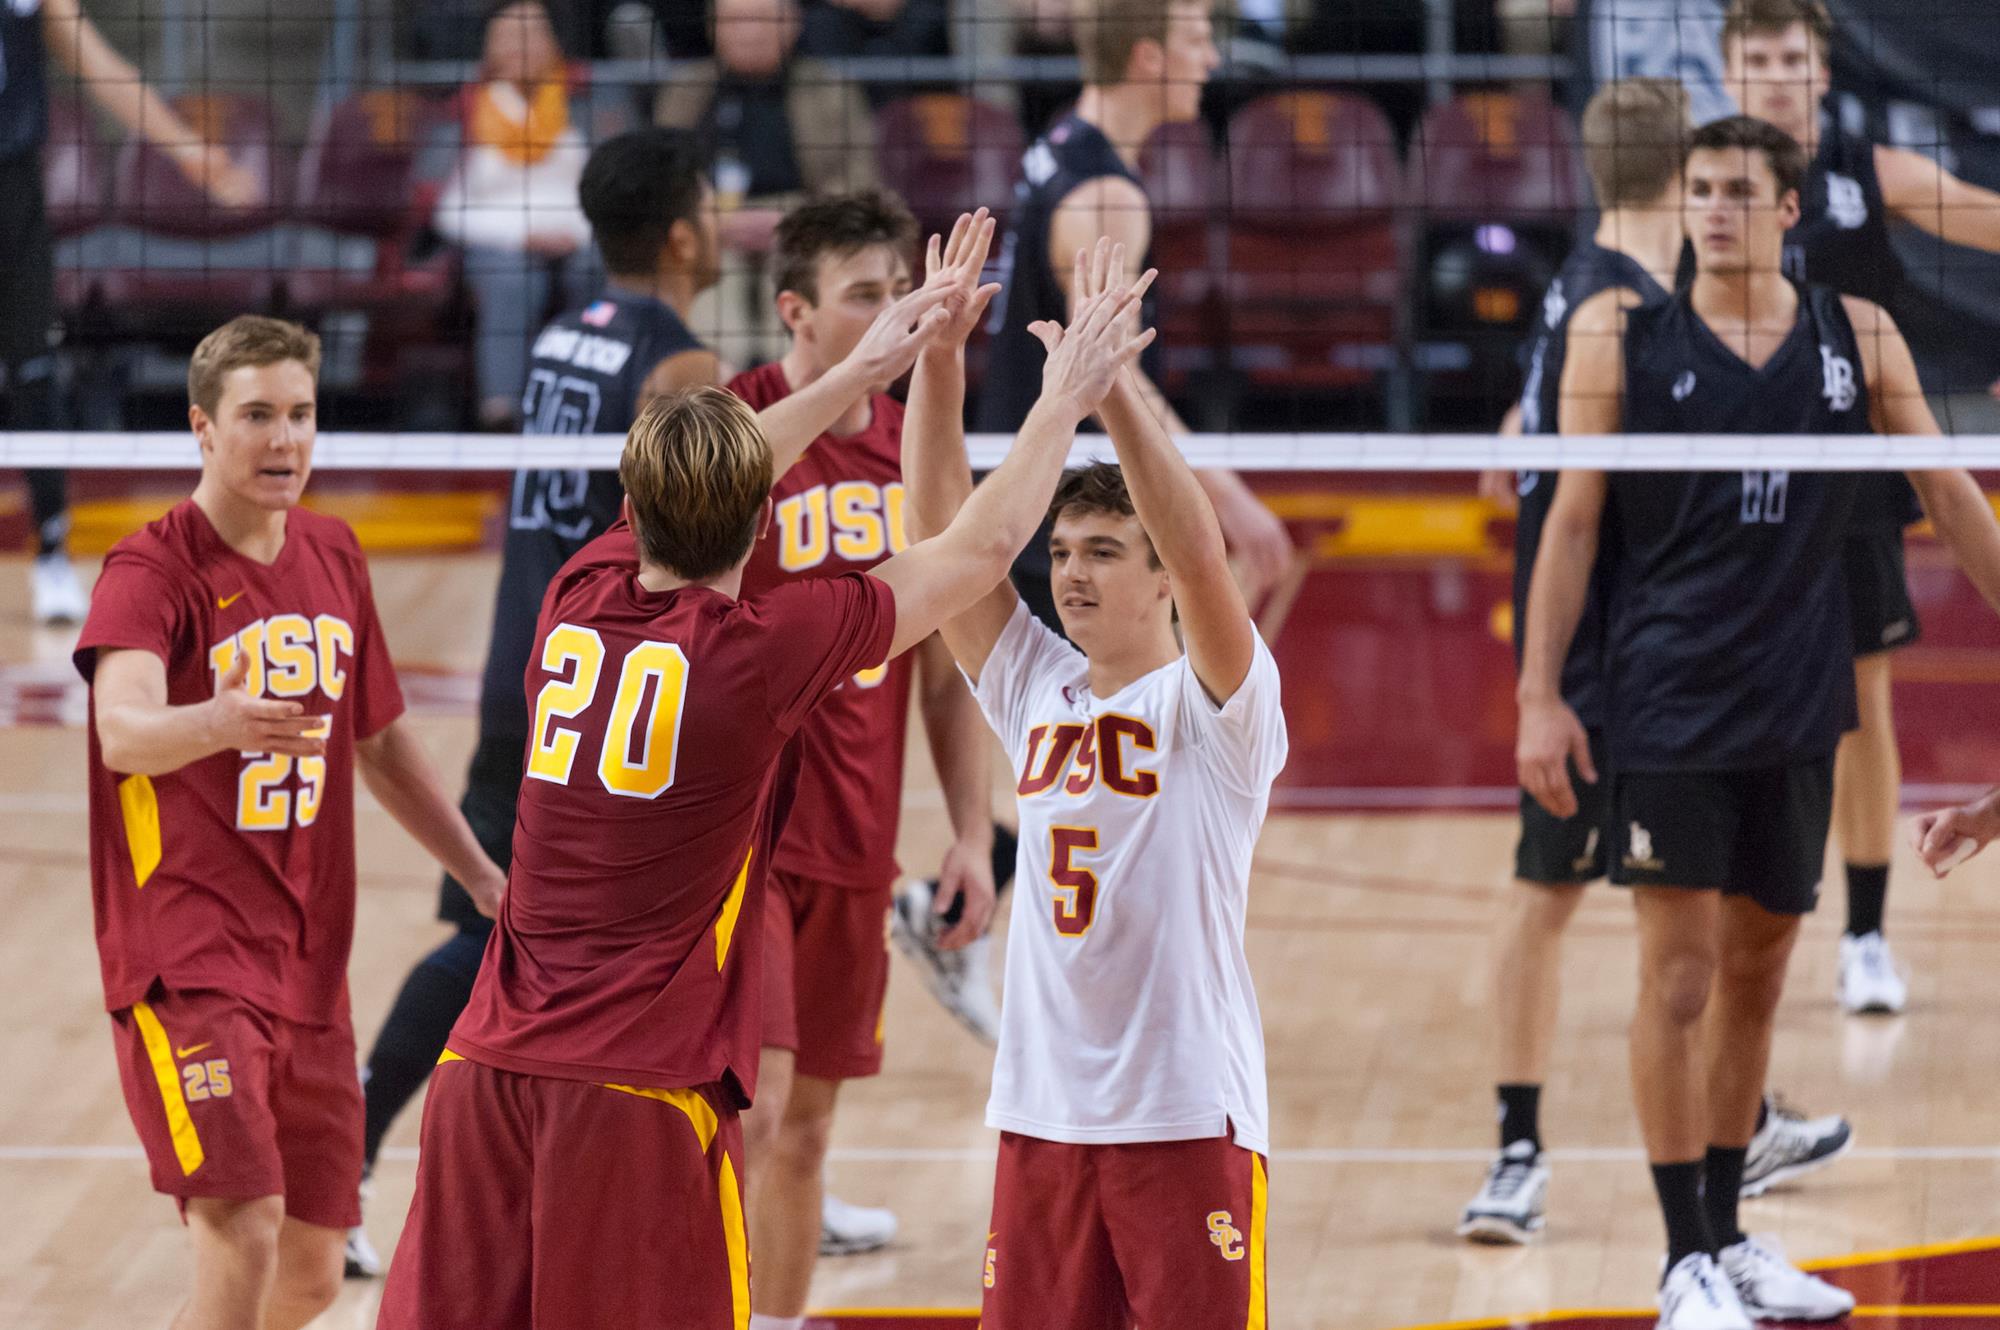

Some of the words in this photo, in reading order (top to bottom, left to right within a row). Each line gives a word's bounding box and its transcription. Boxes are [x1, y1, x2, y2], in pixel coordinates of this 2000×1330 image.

[209, 613, 354, 701] USC
[526, 622, 690, 800] 20
[236, 713, 333, 832] 25
[1016, 711, 1160, 800] USC
[1049, 824, 1098, 938] 5
[182, 1058, 233, 1102] 25
[983, 1247, 997, 1288] 5
[1206, 1210, 1245, 1261] SC
